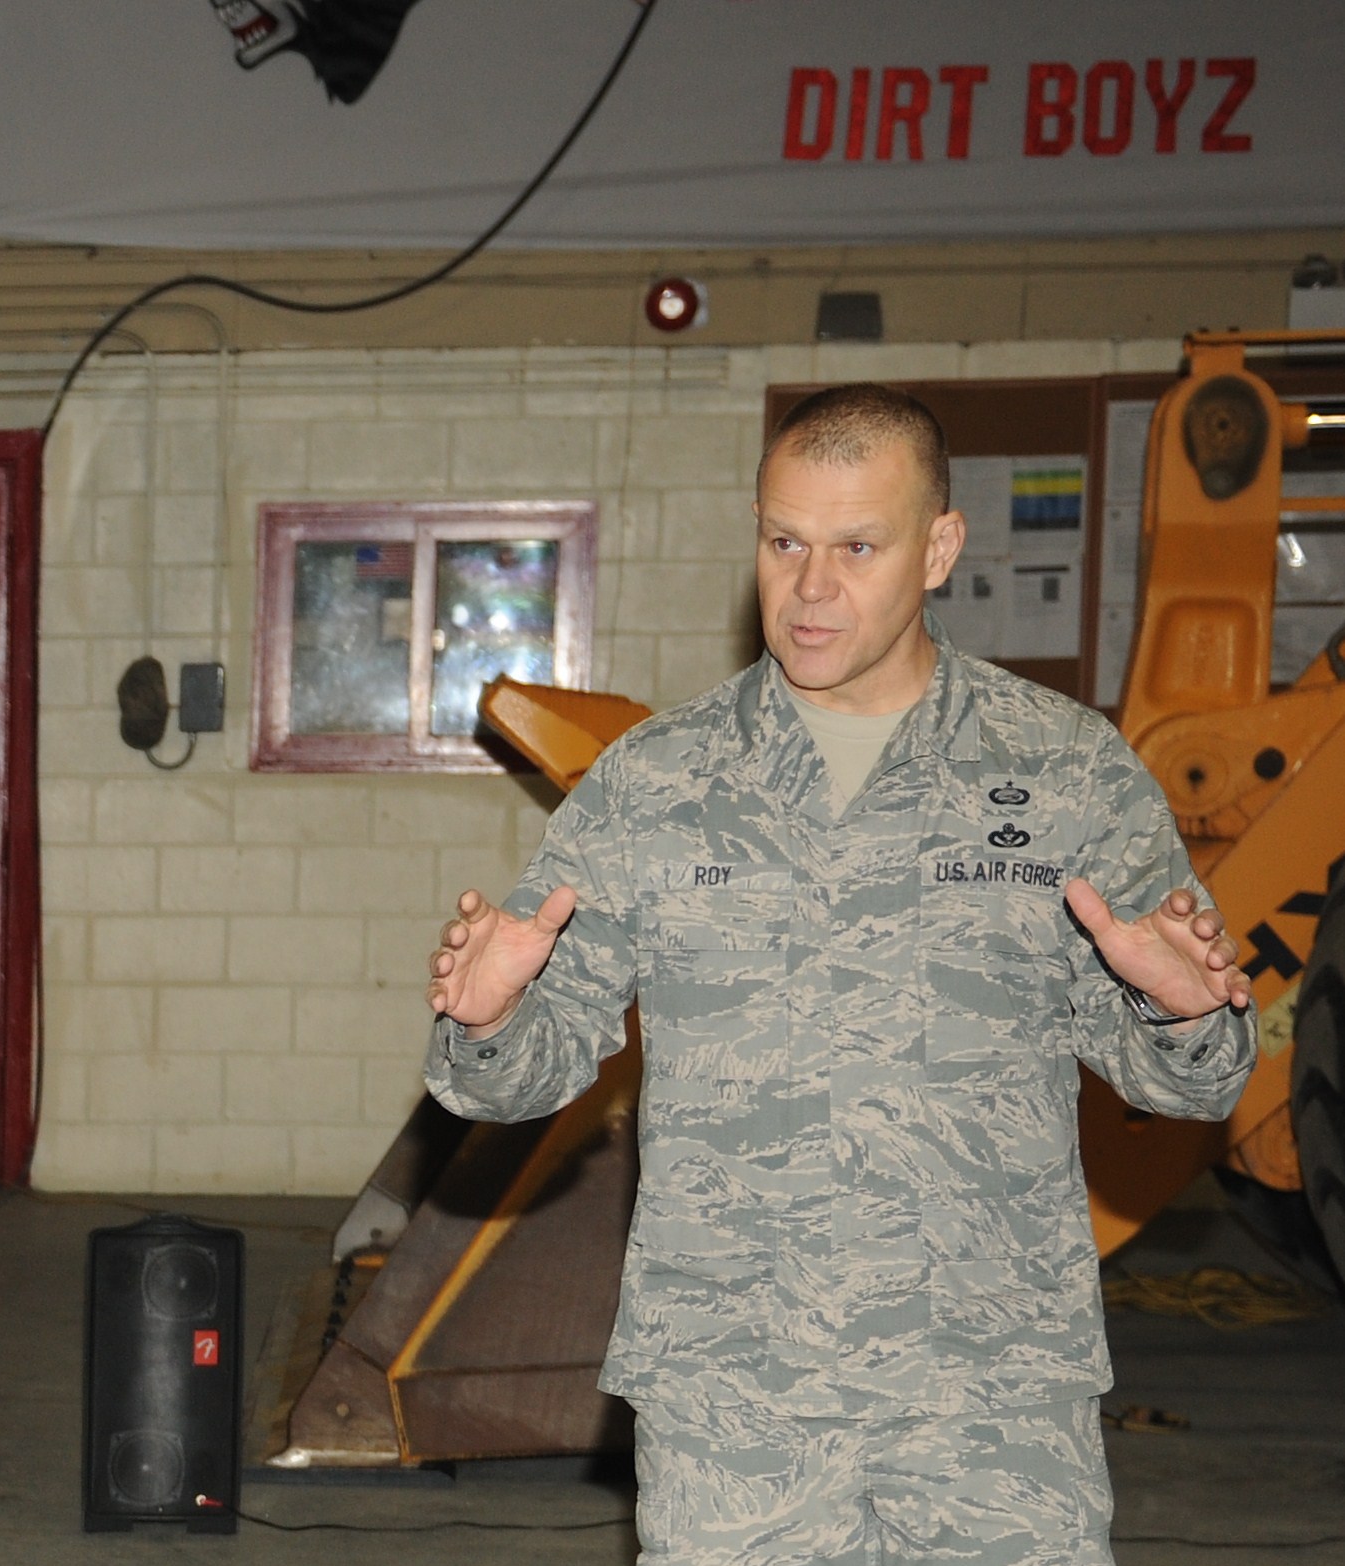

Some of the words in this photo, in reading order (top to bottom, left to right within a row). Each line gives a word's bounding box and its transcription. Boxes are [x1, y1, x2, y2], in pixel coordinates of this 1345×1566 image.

[783, 65, 990, 162] DIRT
[1023, 58, 1257, 157] BOYZ
[694, 865, 732, 886] ROY
[936, 861, 968, 882] U.S.
[973, 861, 1006, 882] AIR
[1012, 863, 1064, 888] FORCE
